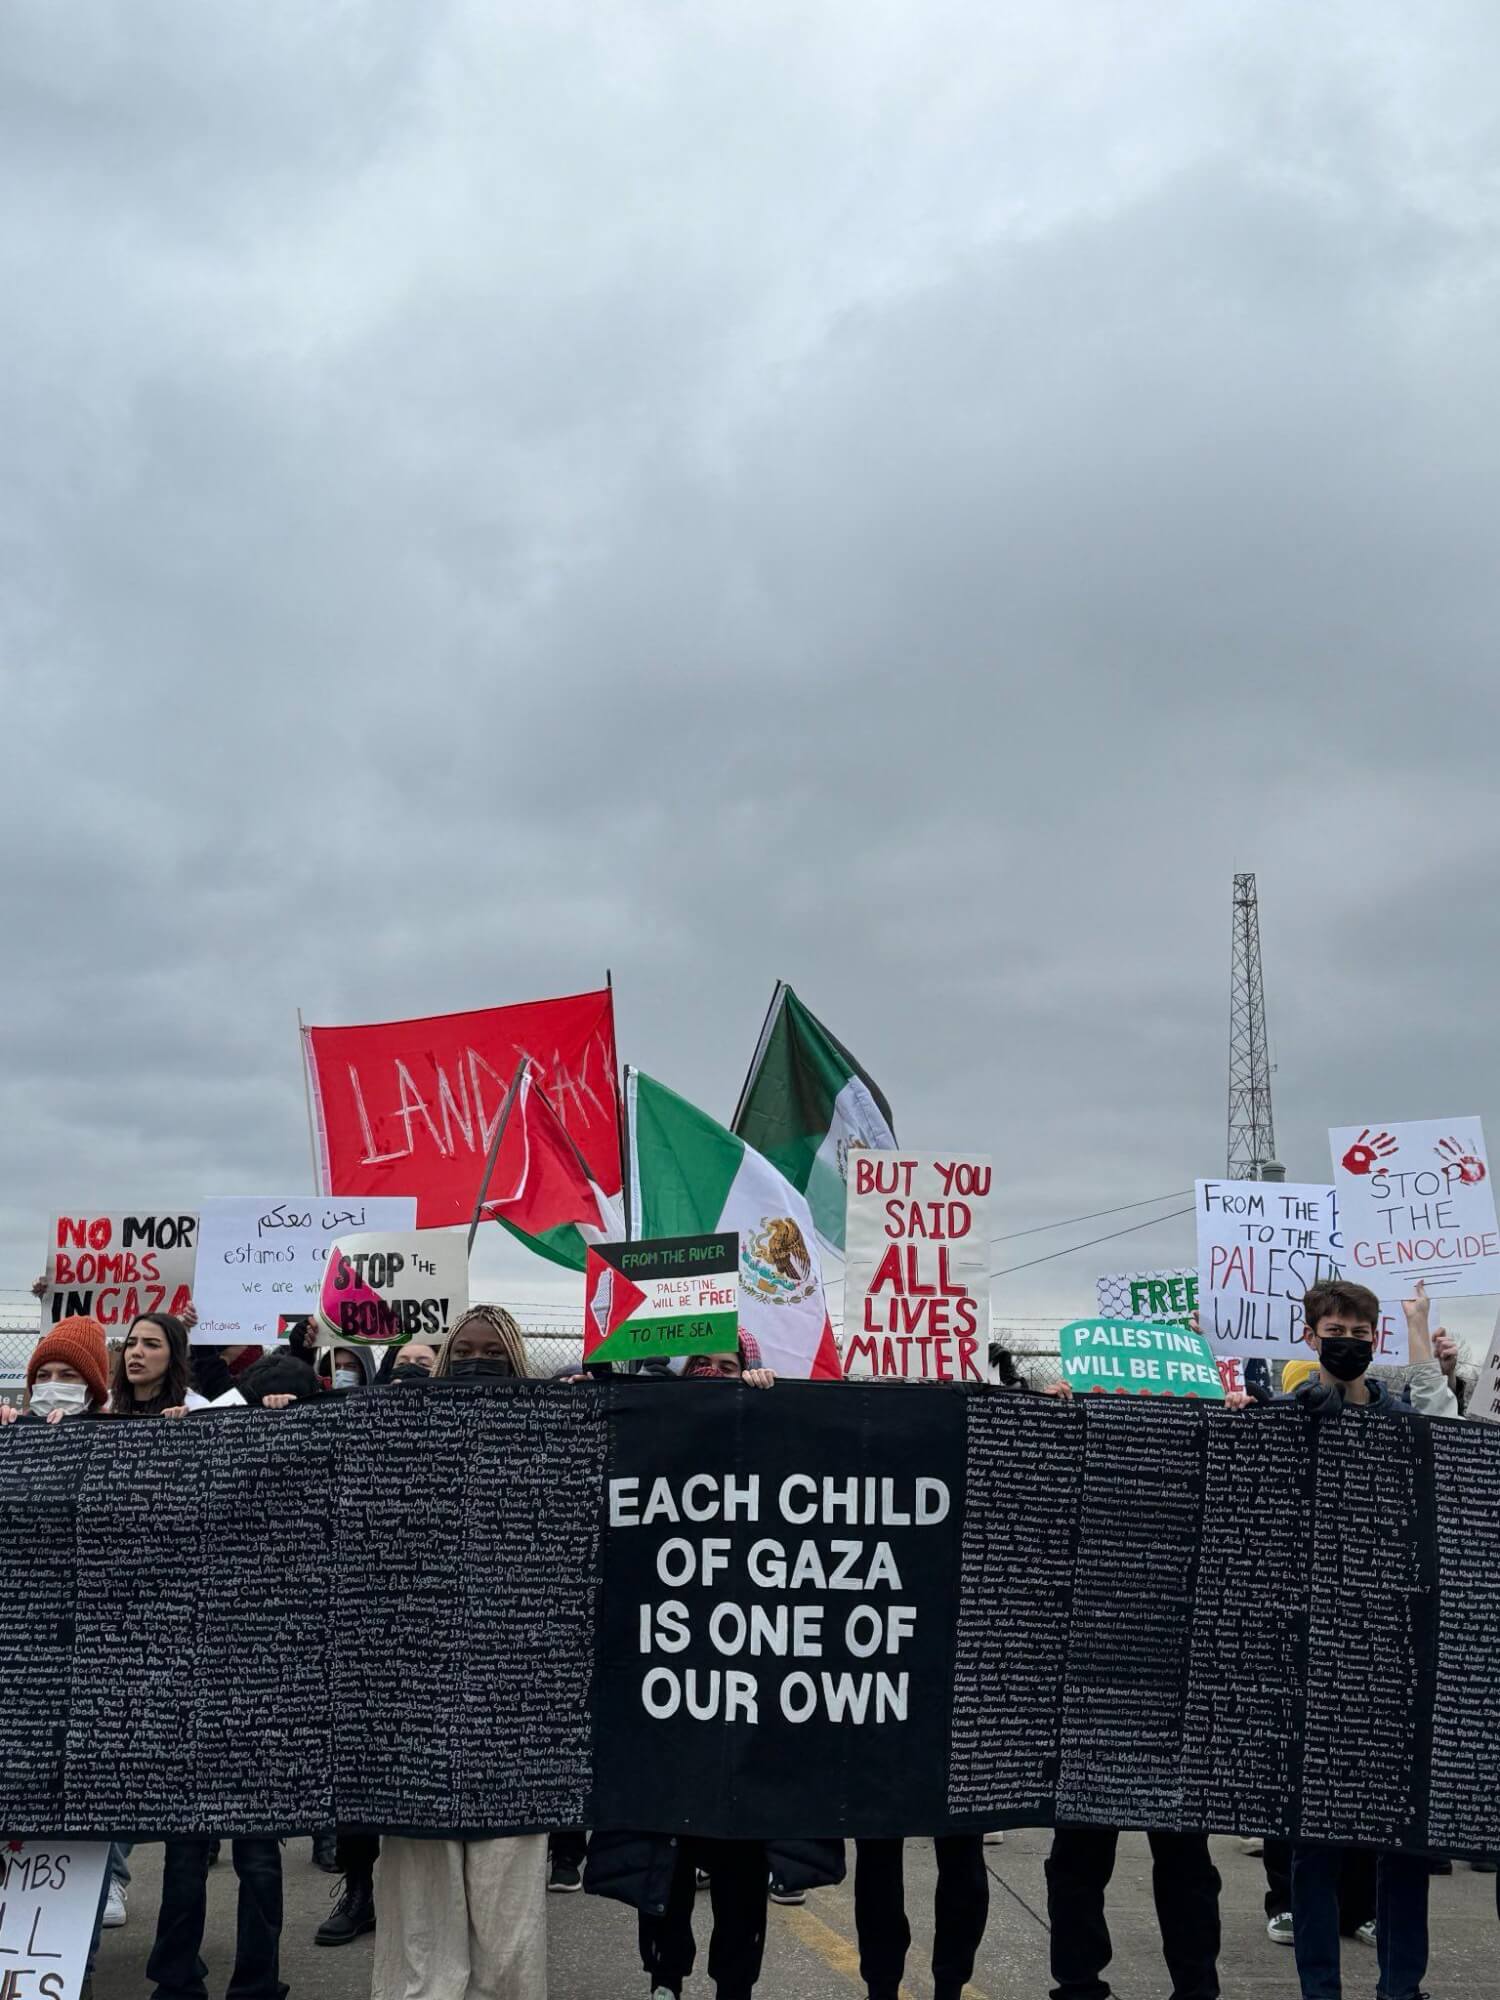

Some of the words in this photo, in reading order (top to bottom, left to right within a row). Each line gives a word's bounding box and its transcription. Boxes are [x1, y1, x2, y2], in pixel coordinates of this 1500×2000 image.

[348, 1046, 509, 1165] LAND
[857, 1159, 918, 1197] BUT
[934, 1161, 991, 1197] YOU
[1371, 1162, 1463, 1199] STOP
[322, 1208, 365, 1230] نحن
[884, 1199, 972, 1240] SAID
[1204, 1184, 1264, 1217] FROM
[1279, 1196, 1320, 1221] THE
[1377, 1201, 1460, 1234] THE
[57, 1216, 112, 1250] NO
[122, 1216, 199, 1249] MOR
[258, 1204, 312, 1238] معكم
[1240, 1224, 1274, 1242] TO
[1281, 1228, 1320, 1249] THE
[55, 1251, 161, 1284] BOMBS
[224, 1243, 295, 1264] estamos
[621, 1253, 657, 1269] FROM
[661, 1248, 688, 1265] THE
[689, 1245, 725, 1261] RIVER
[1354, 1232, 1500, 1267] GENOCIDE
[241, 1281, 263, 1293] we
[271, 1281, 294, 1293] are
[334, 1251, 404, 1291] STOP
[411, 1253, 437, 1275] THE
[656, 1279, 718, 1293] PALESTINE
[866, 1242, 968, 1297] ALL
[51, 1290, 93, 1322] IN
[96, 1283, 192, 1325] GAZA
[340, 1298, 449, 1336] BOMBS!
[652, 1296, 673, 1309] WILL
[679, 1294, 691, 1306] BE
[698, 1289, 737, 1308] FREE!
[864, 1296, 978, 1338] LIVES
[252, 1323, 267, 1332] for
[629, 1328, 651, 1343] TO
[657, 1325, 685, 1340] THE
[689, 1321, 713, 1338] SEA
[1214, 1297, 1280, 1342] WILL
[843, 1333, 984, 1383] MATTER
[1074, 1327, 1205, 1357] PALESTINE
[1065, 1356, 1125, 1377] WILL
[1130, 1358, 1160, 1379] BE
[1166, 1361, 1222, 1386] FREE
[608, 1473, 760, 1527] EACH
[778, 1474, 951, 1526] CHILD
[656, 1537, 732, 1587] OF
[747, 1538, 903, 1590] GAZA
[639, 1600, 692, 1654] IS
[709, 1601, 825, 1657] ONE
[845, 1604, 918, 1658] OF
[641, 1667, 759, 1724] OUR
[779, 1671, 910, 1725] OWN
